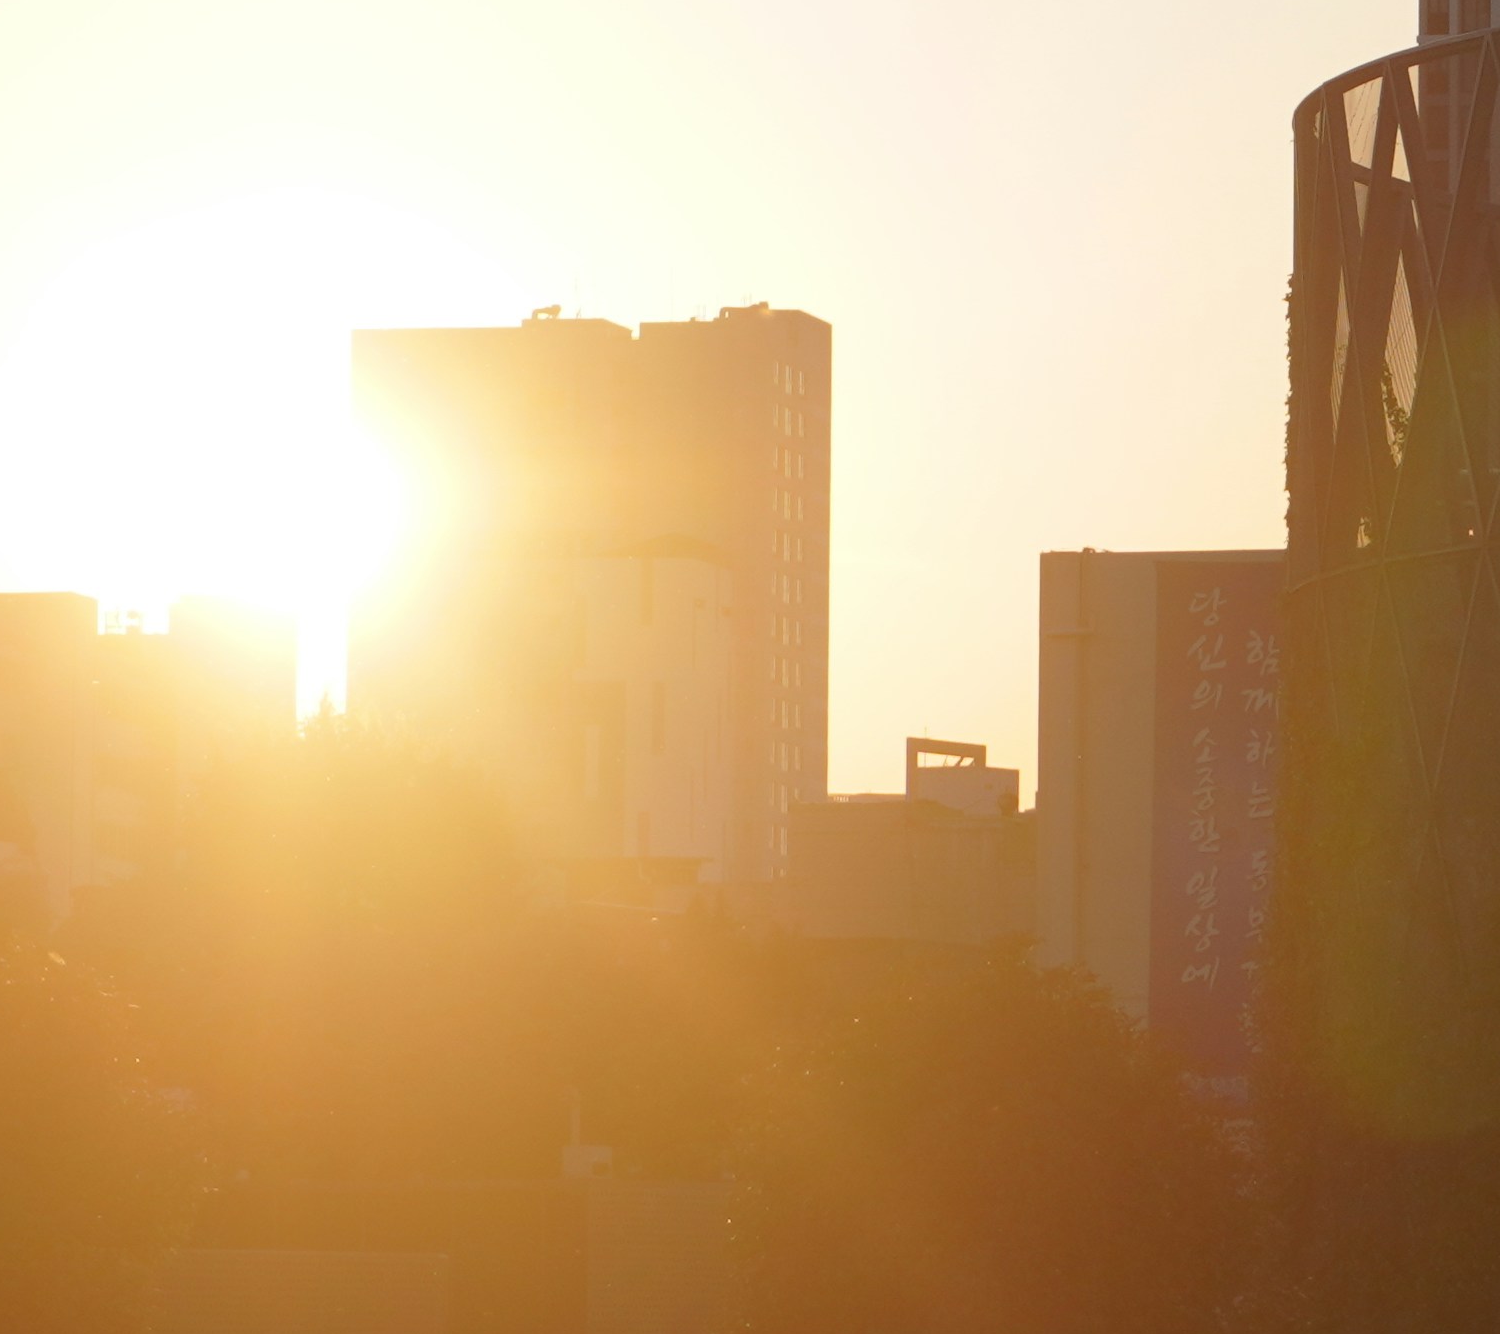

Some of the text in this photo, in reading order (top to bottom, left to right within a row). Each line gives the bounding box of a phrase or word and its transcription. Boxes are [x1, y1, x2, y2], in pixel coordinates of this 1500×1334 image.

[1180, 587, 1226, 991] 당신의 소중한 일상에
